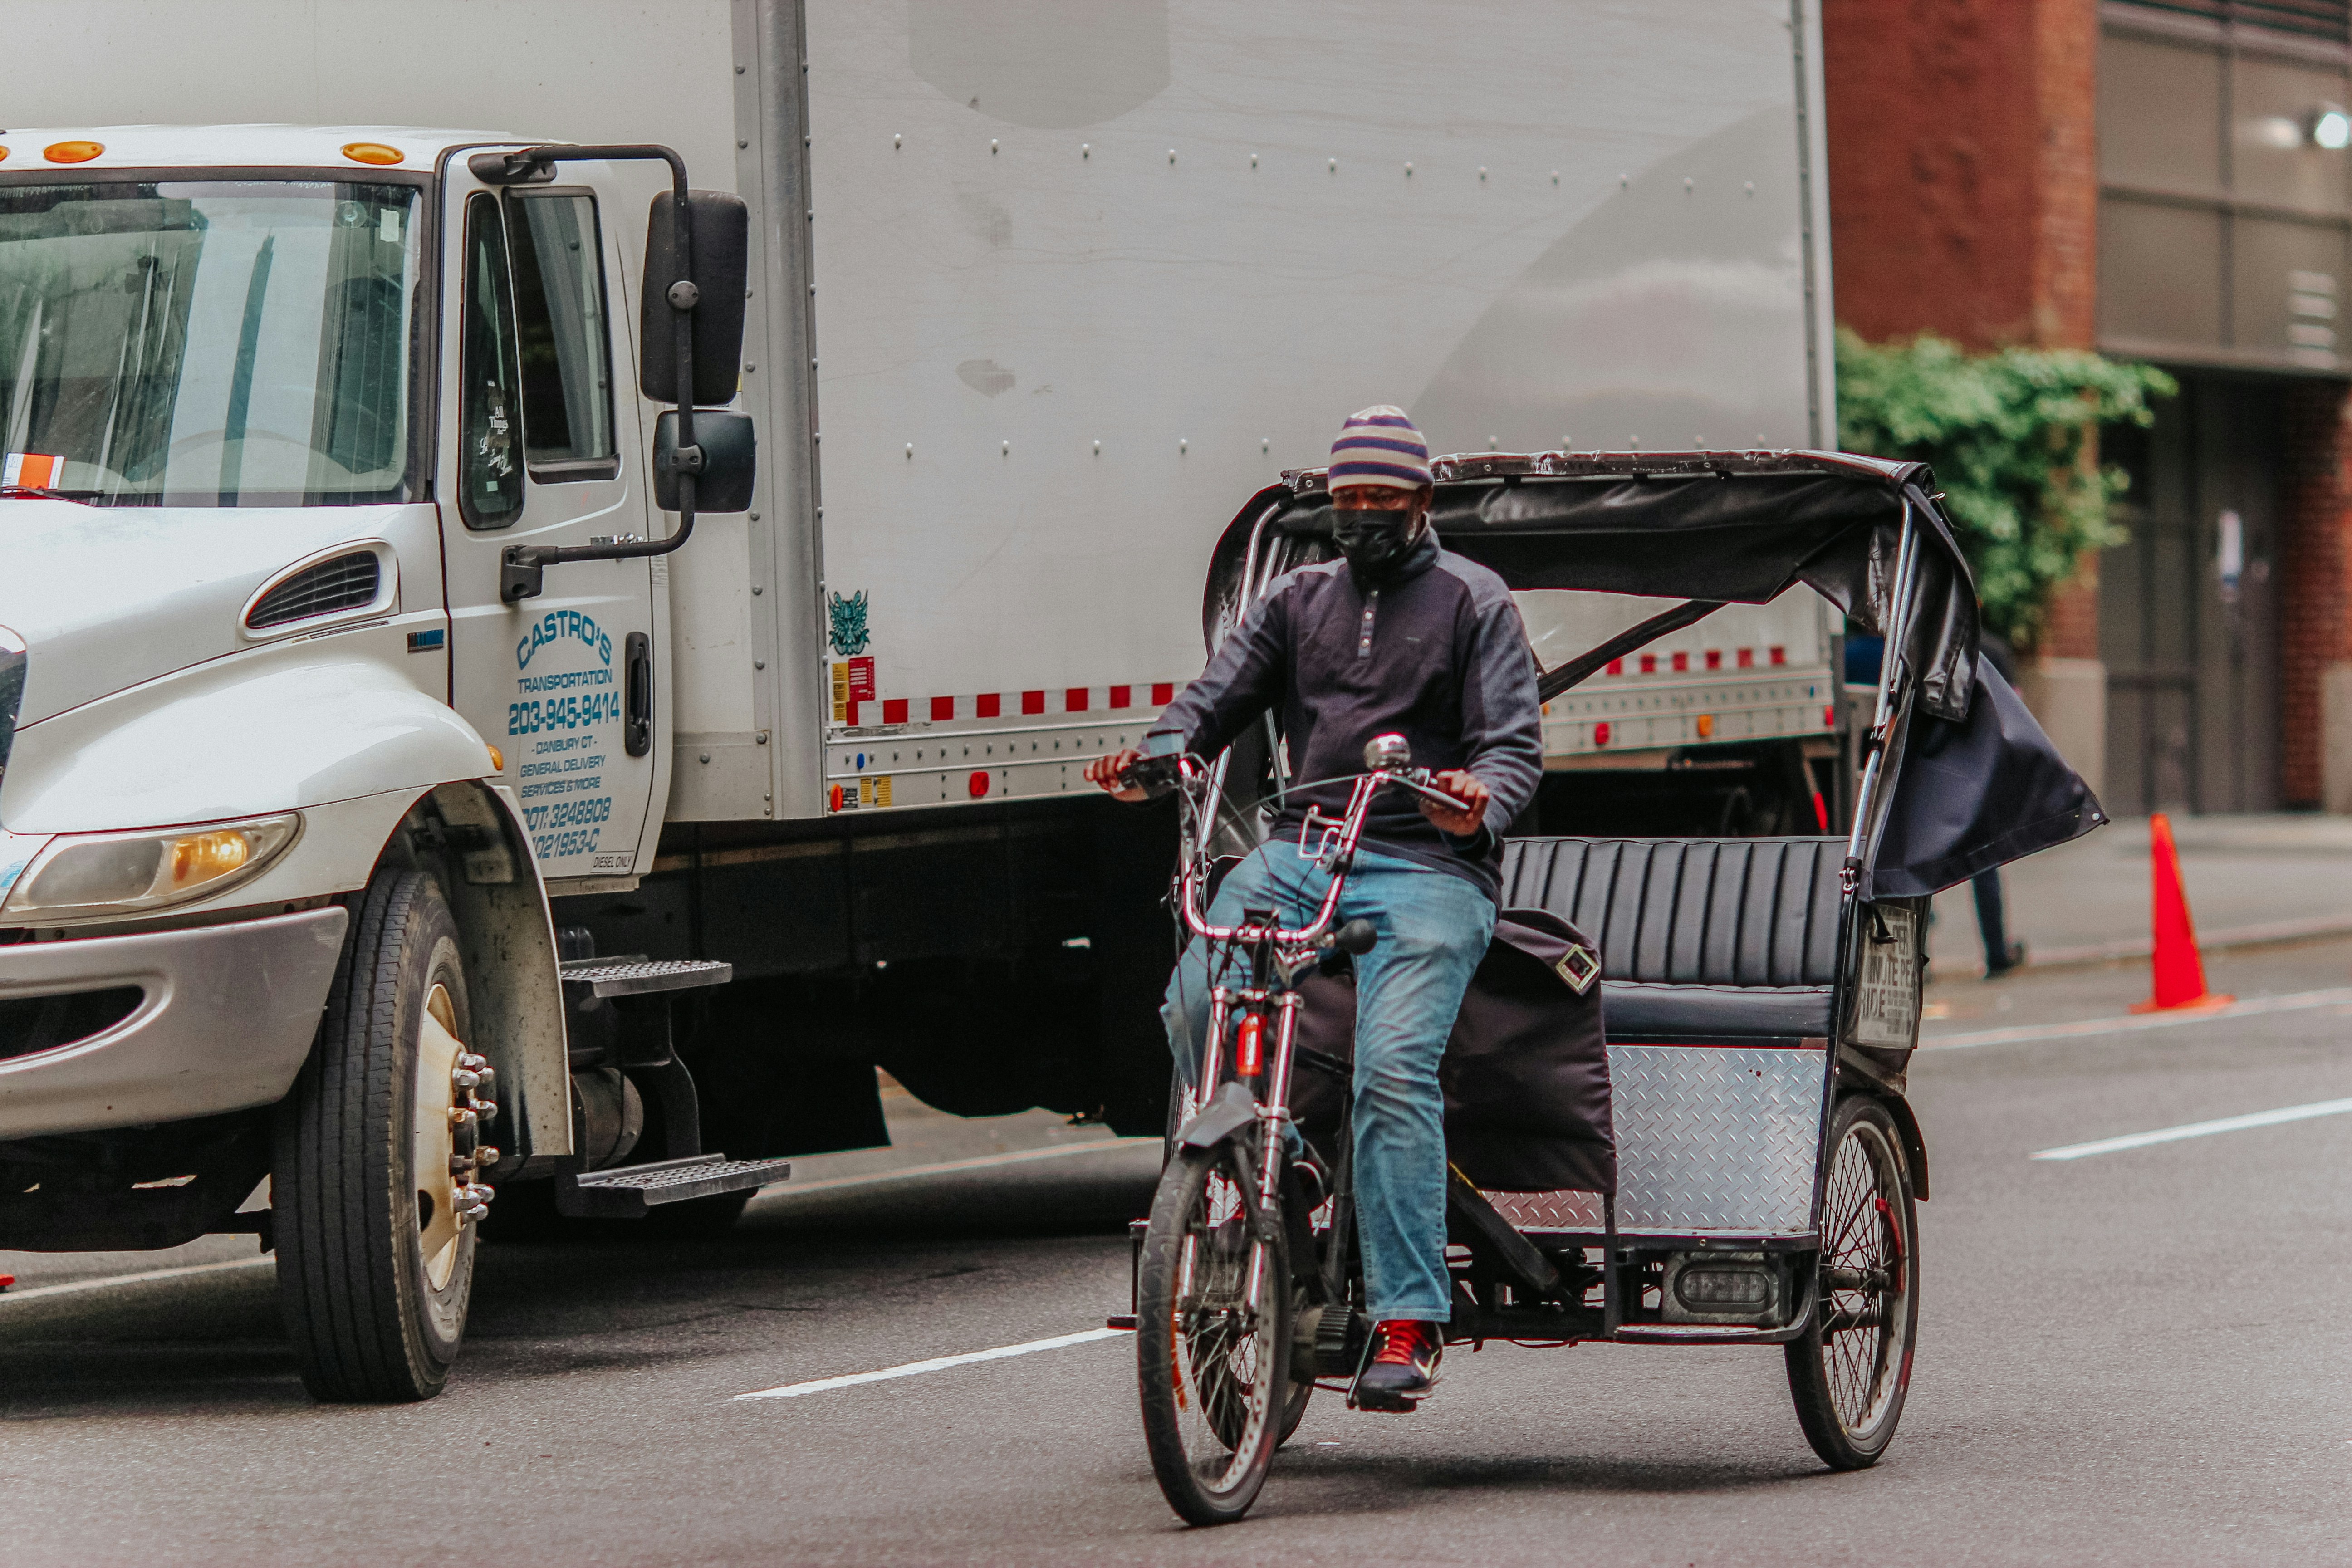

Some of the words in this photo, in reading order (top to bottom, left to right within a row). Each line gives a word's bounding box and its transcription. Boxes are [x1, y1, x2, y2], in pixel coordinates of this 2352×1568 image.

[517, 610, 612, 670] CASTRO'S
[518, 669, 612, 693] TRANSPORTATION
[509, 691, 620, 735] 203-945-9414
[536, 737, 580, 755] DANBURY
[581, 735, 593, 749] CT
[520, 761, 562, 778] GENERAL
[564, 755, 606, 772] DELIVERY
[521, 780, 565, 798] SERVICES
[566, 780, 574, 792] &
[574, 776, 601, 792] MORE
[549, 797, 612, 828] 3248808
[593, 856, 614, 868] DIESEL
[616, 856, 632, 867] ONLY
[1861, 987, 1886, 1018] RIDE
